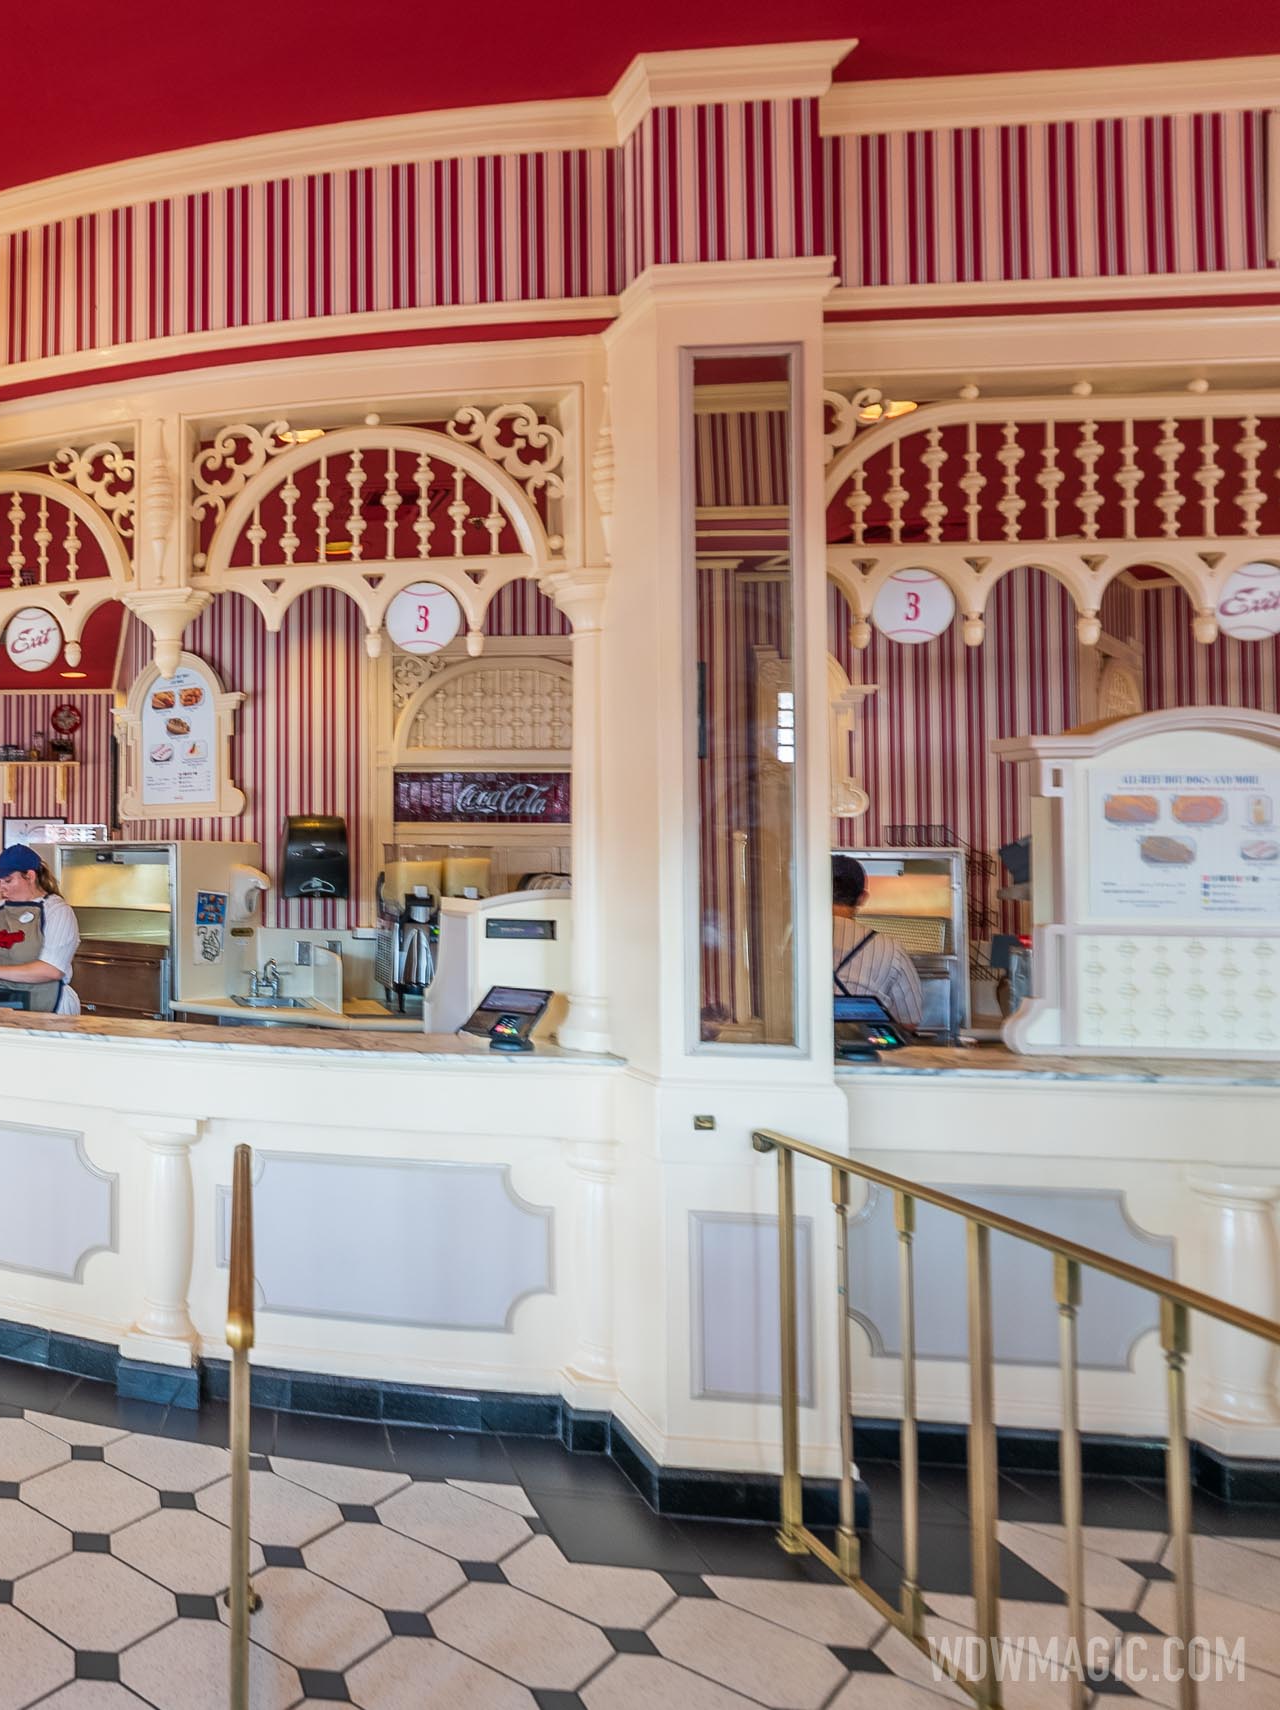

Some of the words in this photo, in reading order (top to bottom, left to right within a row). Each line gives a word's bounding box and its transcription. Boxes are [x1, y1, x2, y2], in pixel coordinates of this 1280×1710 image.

[416, 605, 429, 632] 3
[905, 592, 920, 621] 3
[11, 627, 57, 654] Exit
